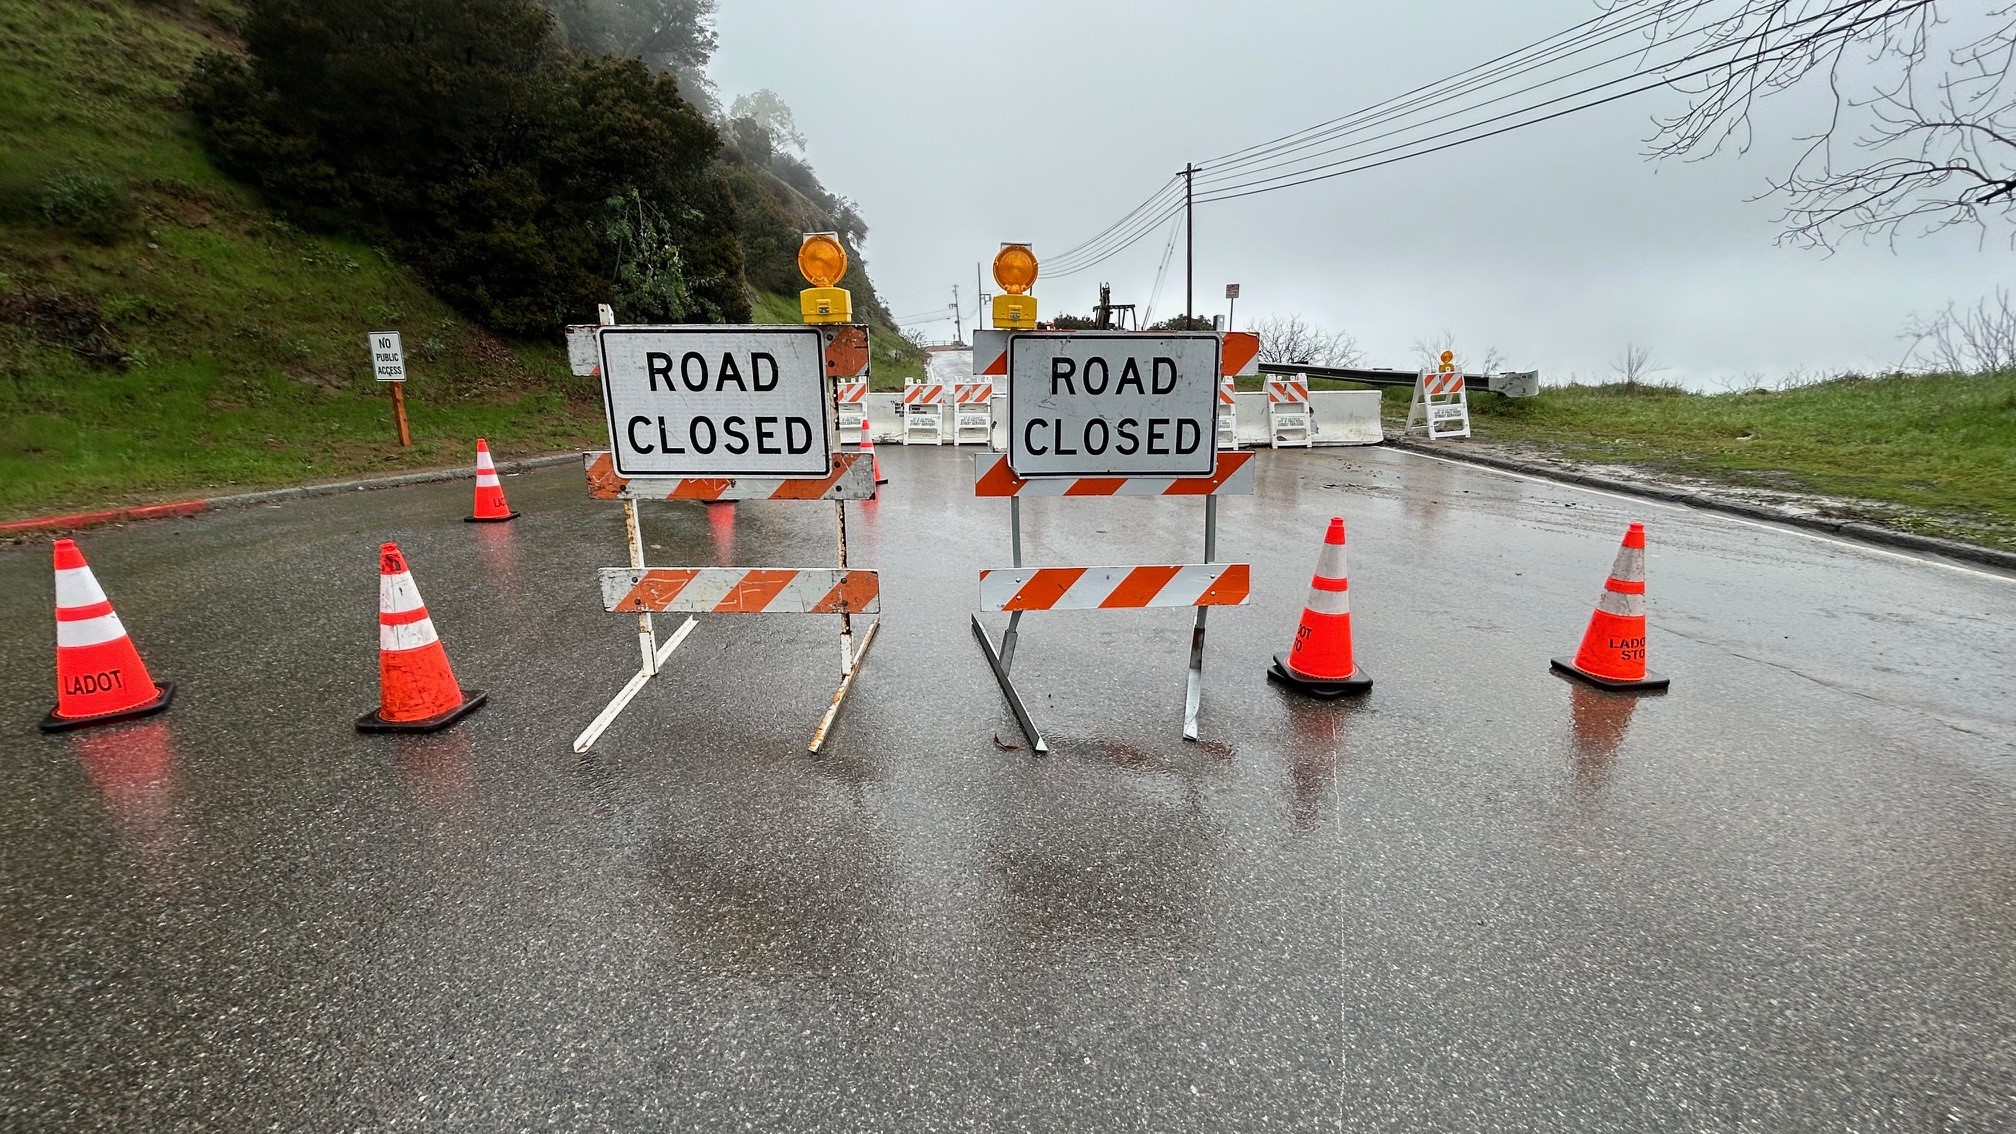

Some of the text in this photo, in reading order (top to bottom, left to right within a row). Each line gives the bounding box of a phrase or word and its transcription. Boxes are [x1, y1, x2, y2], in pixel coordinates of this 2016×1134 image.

[376, 353, 399, 362] PUBLIC
[378, 337, 391, 348] NO
[378, 366, 402, 376] ACCESS
[646, 352, 779, 392] ROAD
[1051, 356, 1178, 395] ROAD
[627, 415, 812, 455] CLOSED
[1024, 418, 1201, 456] CLOSED
[64, 669, 123, 696] LADOT
